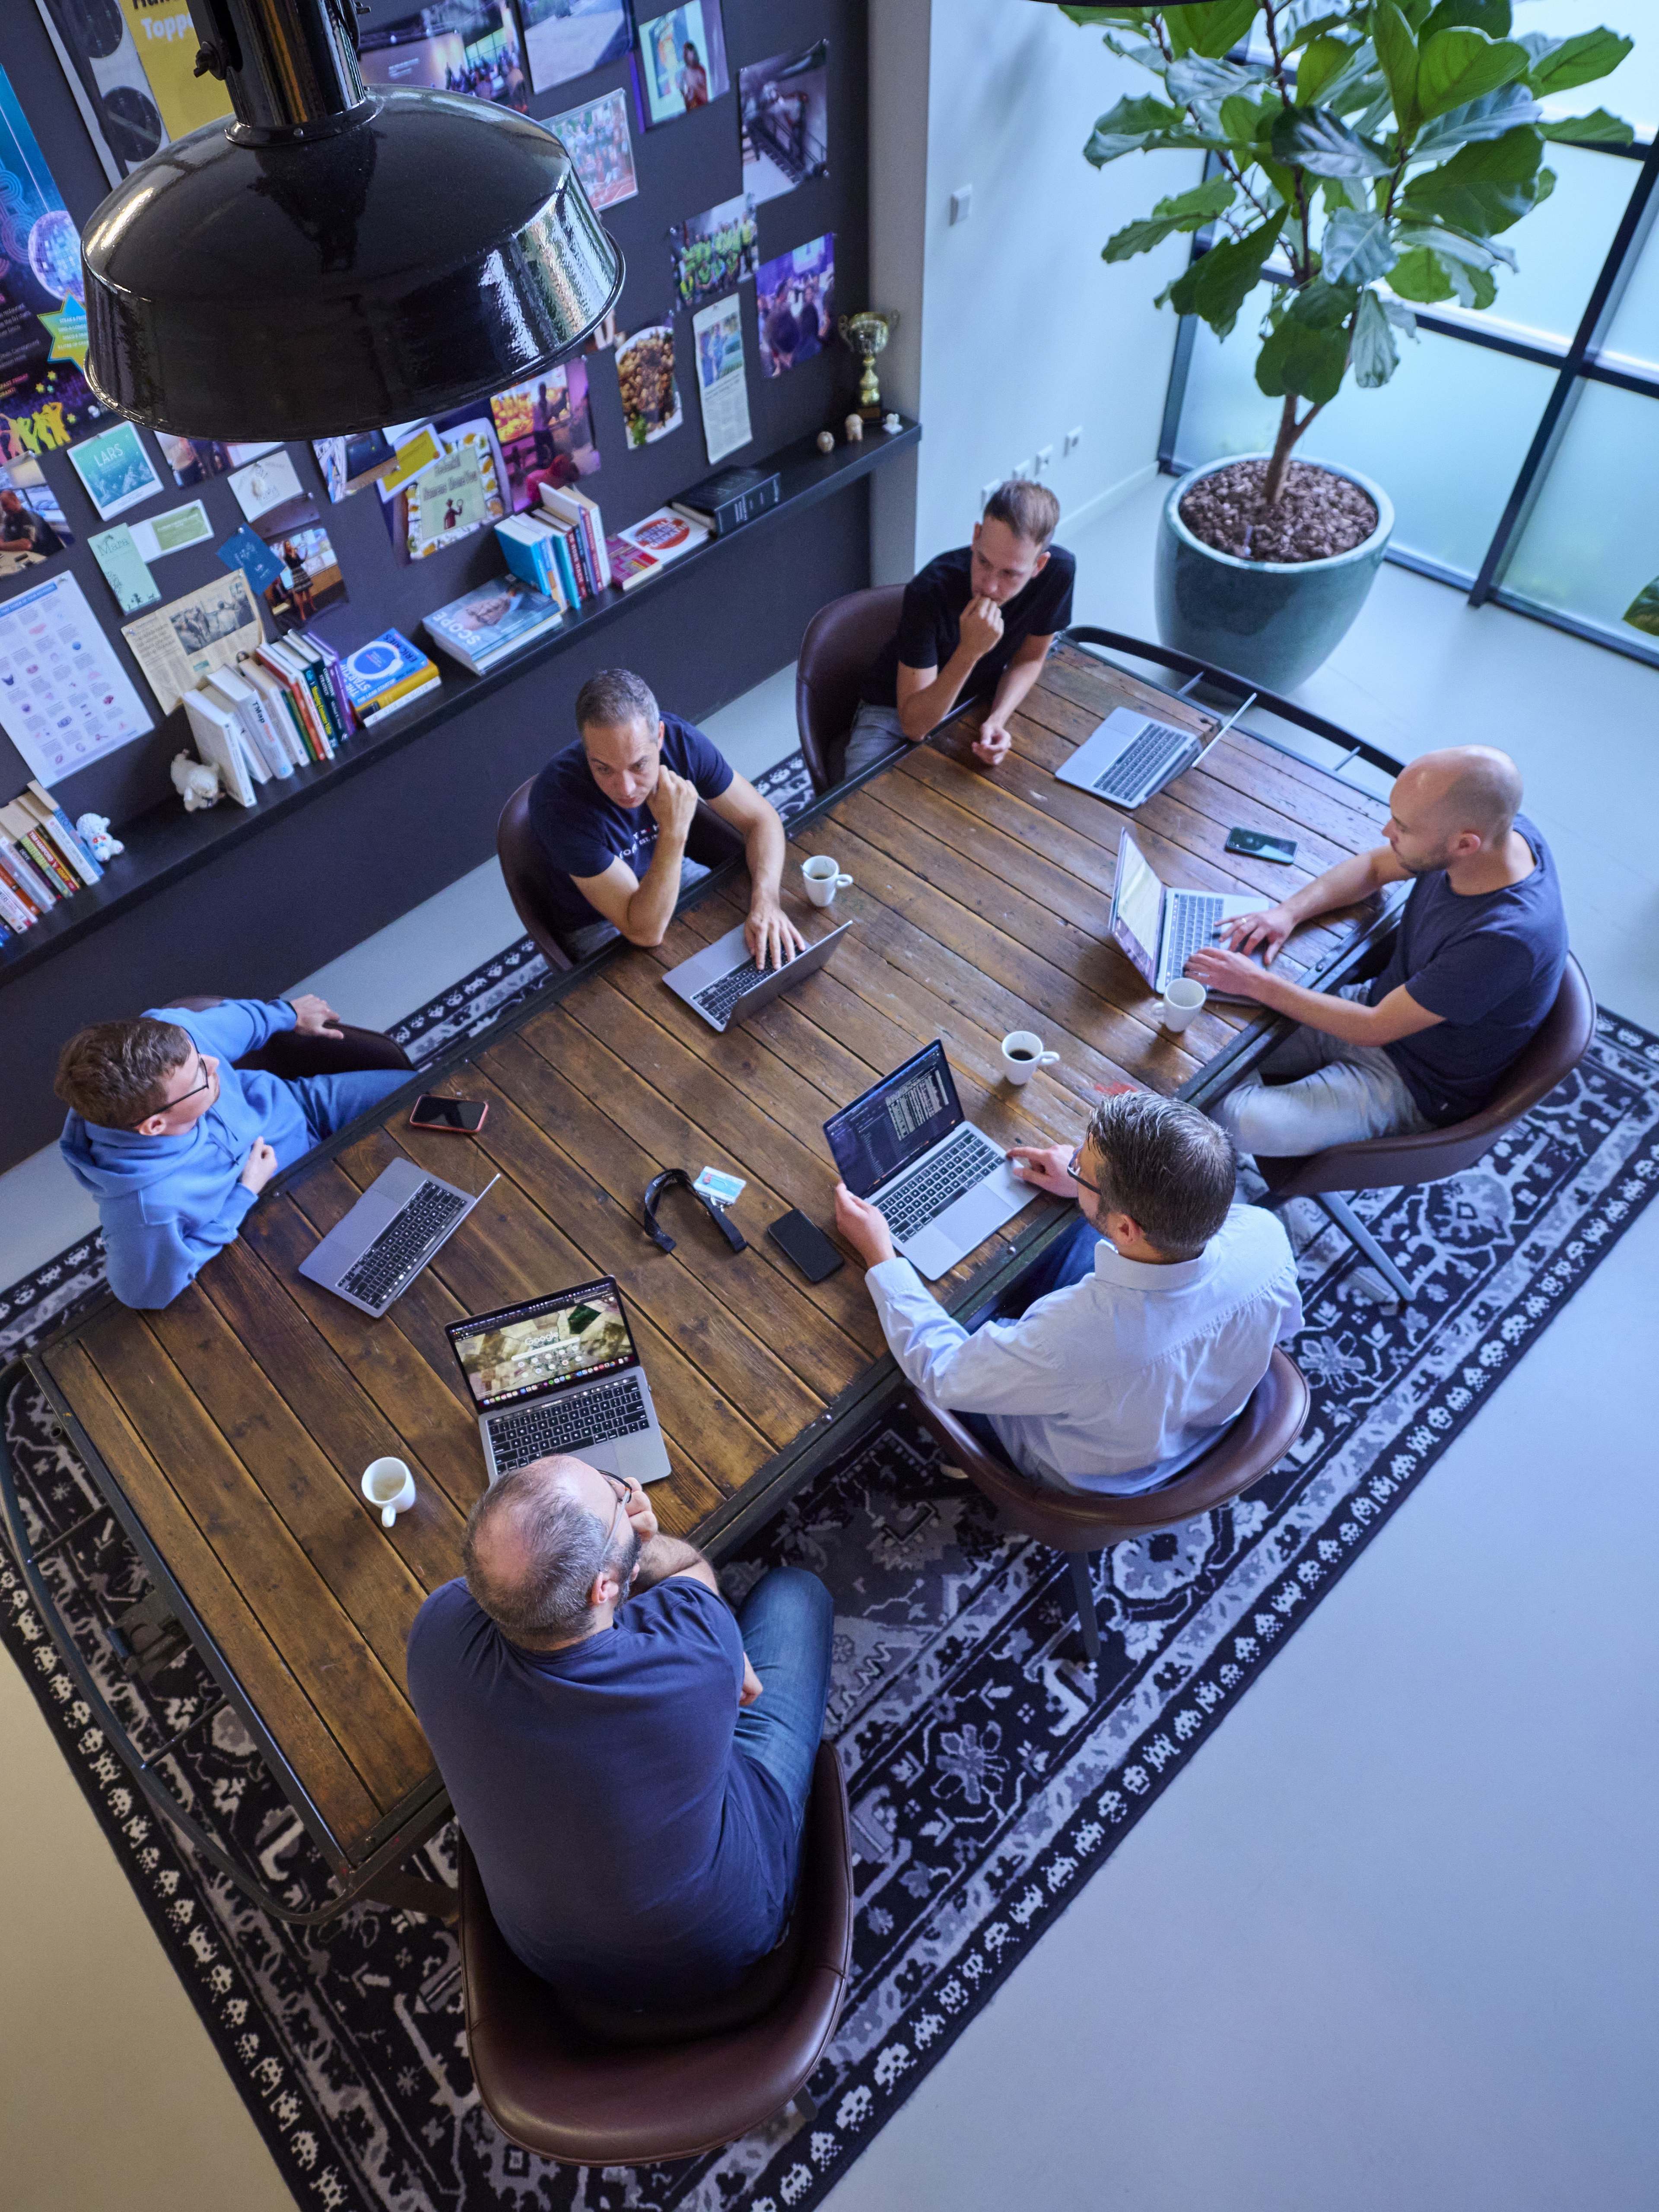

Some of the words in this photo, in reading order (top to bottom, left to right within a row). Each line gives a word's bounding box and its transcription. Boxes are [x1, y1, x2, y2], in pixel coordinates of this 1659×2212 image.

[94, 443, 124, 467] LARS
[433, 611, 481, 644] SCOPE
[319, 674, 329, 696] STRATEGY
[252, 700, 265, 724] TMap
[29, 831, 38, 842] TIM
[36, 840, 54, 862] HARFORD
[524, 1331, 559, 1345] Google
